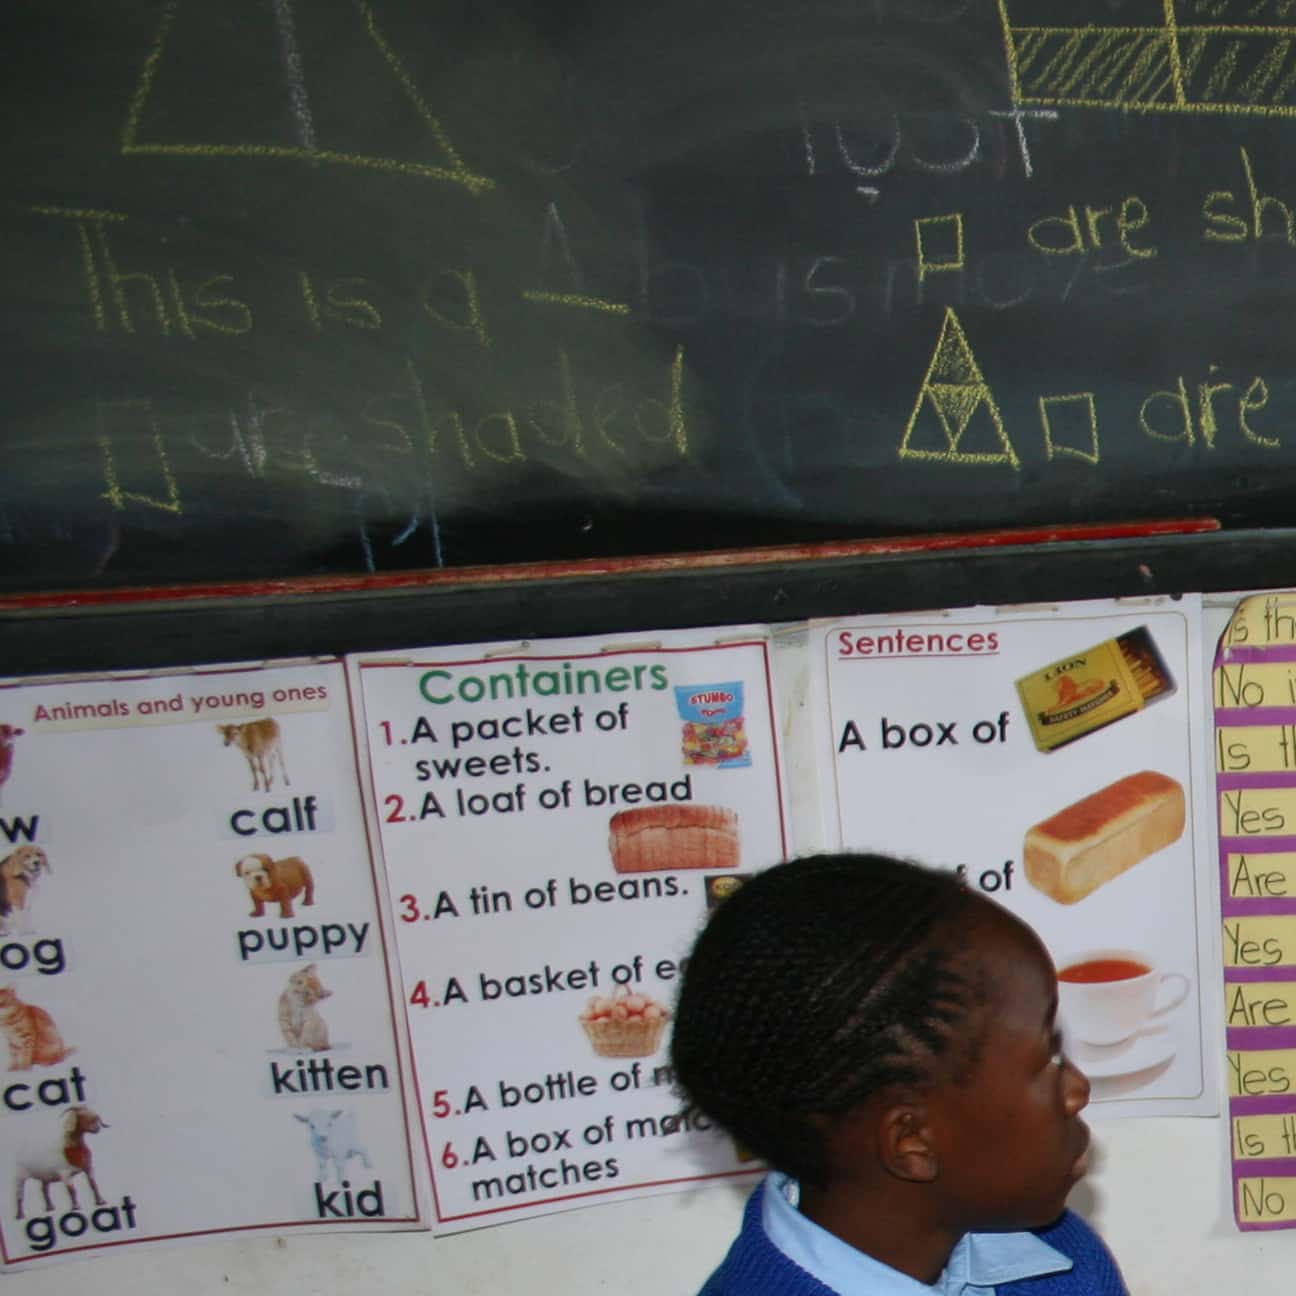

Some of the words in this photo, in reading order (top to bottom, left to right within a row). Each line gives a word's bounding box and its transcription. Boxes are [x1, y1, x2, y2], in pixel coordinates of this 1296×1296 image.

[1028, 197, 1157, 258] are
[31, 206, 252, 338] This
[300, 270, 382, 331] is
[1140, 366, 1279, 449] are
[838, 629, 999, 656] Sentences
[418, 662, 669, 706] Containers
[1045, 657, 1087, 681] LION
[1220, 663, 1264, 708] No
[33, 699, 130, 723] Animals
[137, 695, 183, 716] and
[190, 689, 265, 714] young
[272, 684, 328, 702] ones
[452, 706, 584, 749] packet
[595, 703, 629, 732] of
[838, 720, 866, 752] A
[881, 718, 957, 749] box
[973, 711, 1009, 744] of
[415, 747, 551, 781] sweets.
[1218, 728, 1250, 772] Is
[229, 796, 319, 837] calf
[457, 782, 526, 817] loaf
[538, 780, 572, 809] of
[585, 774, 693, 805] bread
[1224, 790, 1285, 834] Yes
[470, 886, 512, 914] tin
[525, 879, 558, 910] of
[569, 873, 689, 904] beans.
[980, 860, 1014, 893] of
[1231, 855, 1287, 896] Are
[0, 938, 66, 975] og
[238, 922, 370, 960] puppy
[1224, 923, 1282, 965] Yes
[480, 961, 600, 1001] basket
[611, 955, 642, 985] of
[1229, 986, 1290, 1026] Are
[3, 1066, 86, 1111] cat
[271, 1058, 389, 1094] kitten
[500, 1072, 597, 1109] bottle
[611, 1063, 641, 1092] of
[1227, 1053, 1290, 1095] Yes
[507, 1129, 572, 1158] box
[584, 1116, 613, 1144] of
[1236, 1119, 1265, 1156] Is
[314, 1179, 385, 1218] kid
[473, 1157, 619, 1201] matches
[1242, 1177, 1285, 1216] No
[25, 1196, 137, 1251] goat
